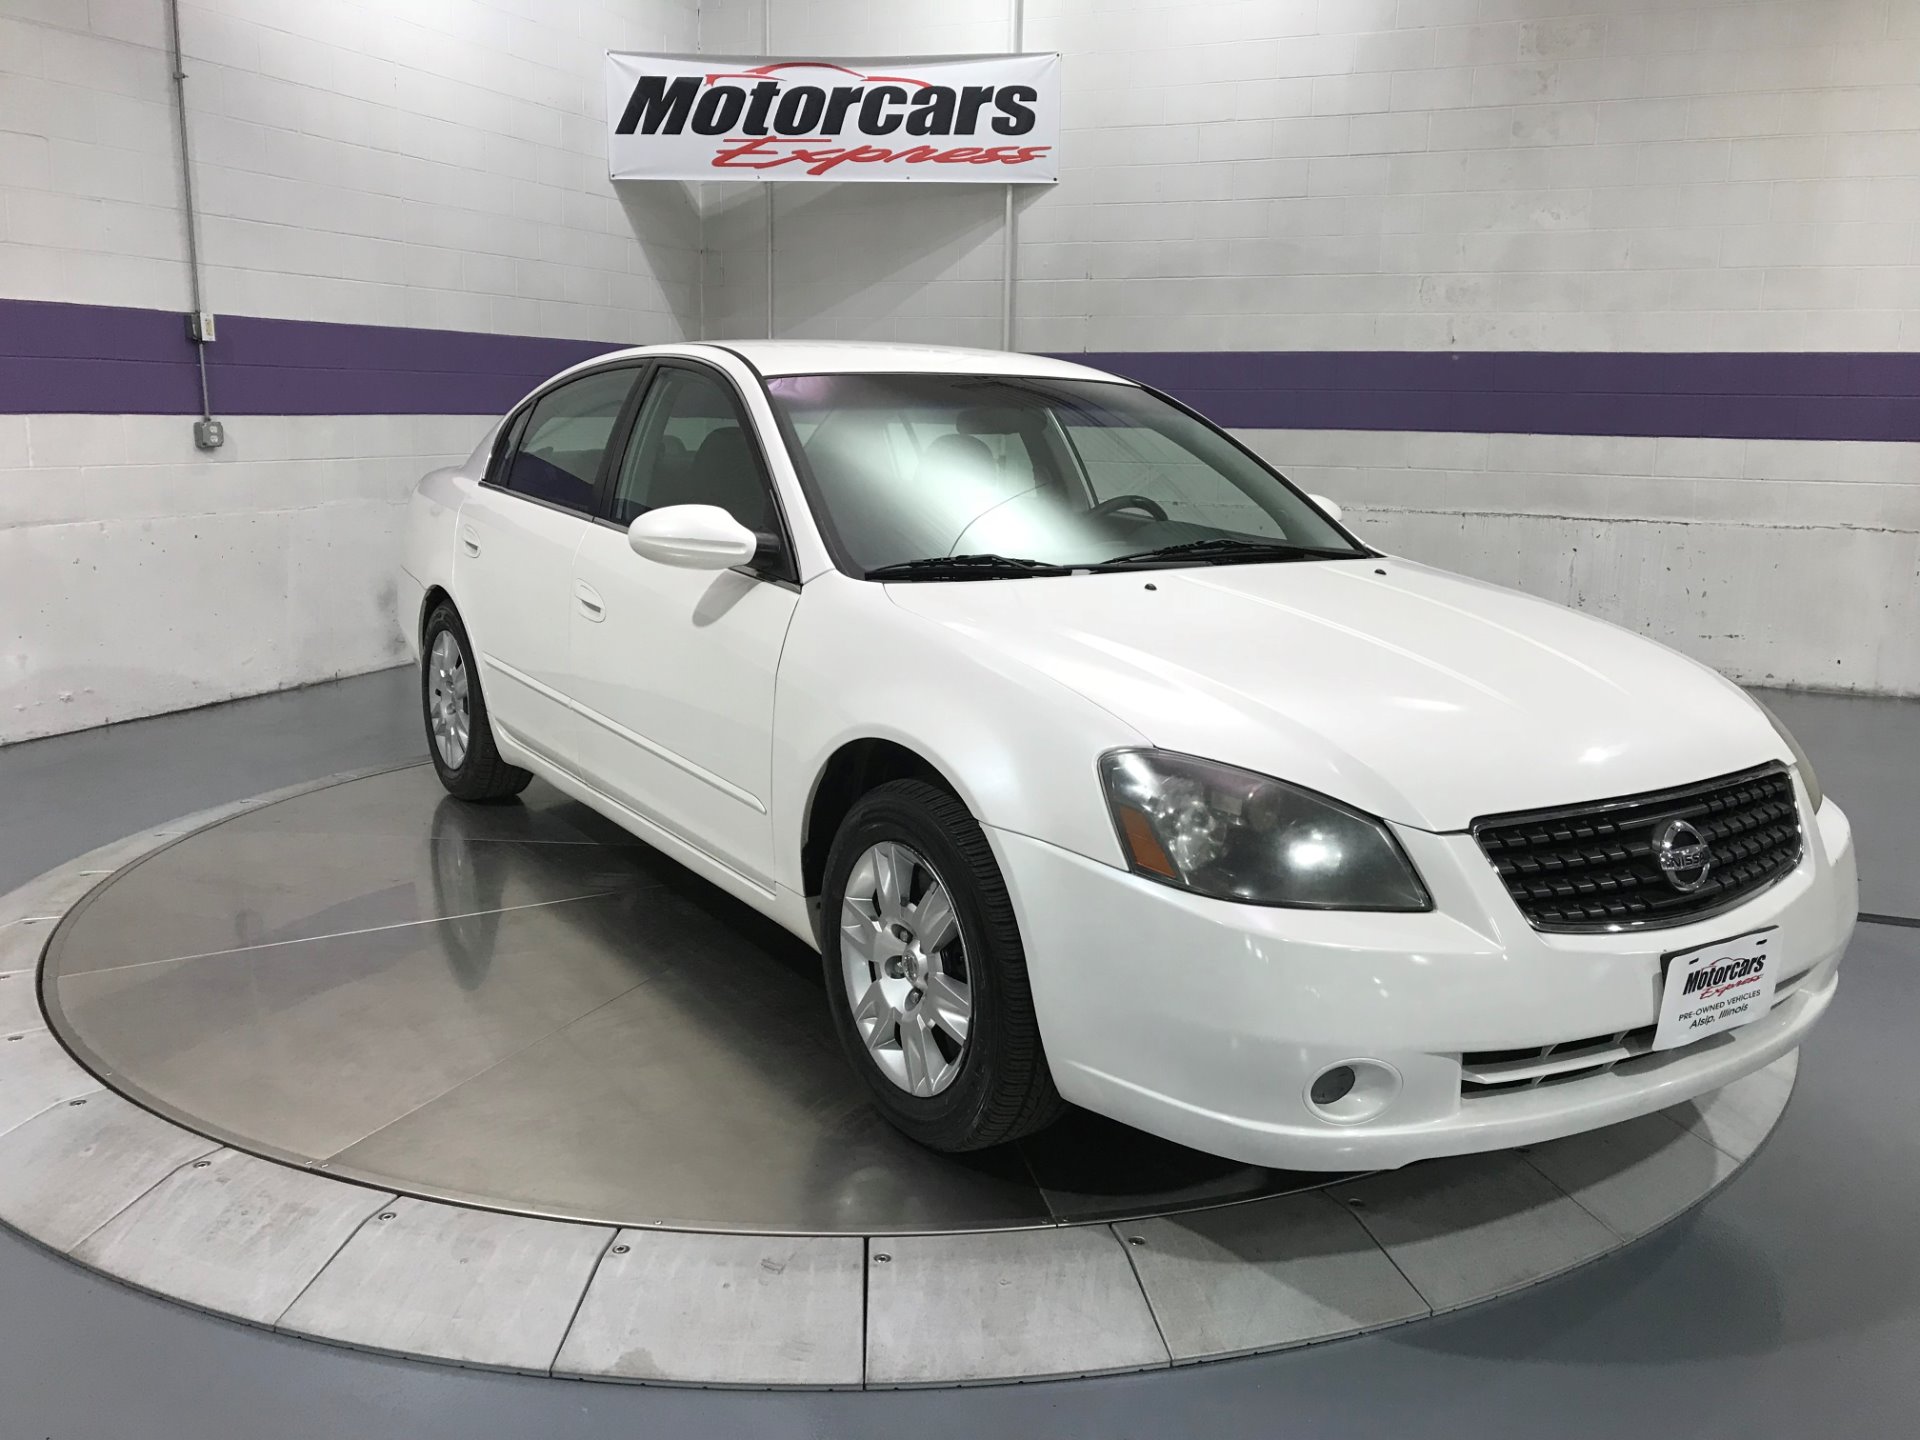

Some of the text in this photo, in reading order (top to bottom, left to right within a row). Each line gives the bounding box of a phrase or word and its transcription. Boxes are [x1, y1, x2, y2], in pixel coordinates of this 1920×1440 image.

[615, 75, 1038, 136] Motorcars
[711, 136, 1052, 176] Express
[1682, 954, 1767, 996] Motorcars
[1678, 989, 1761, 1022] PRE-OWNED VEHICLES
[1689, 1003, 1749, 1030] Alsip, Illinois
